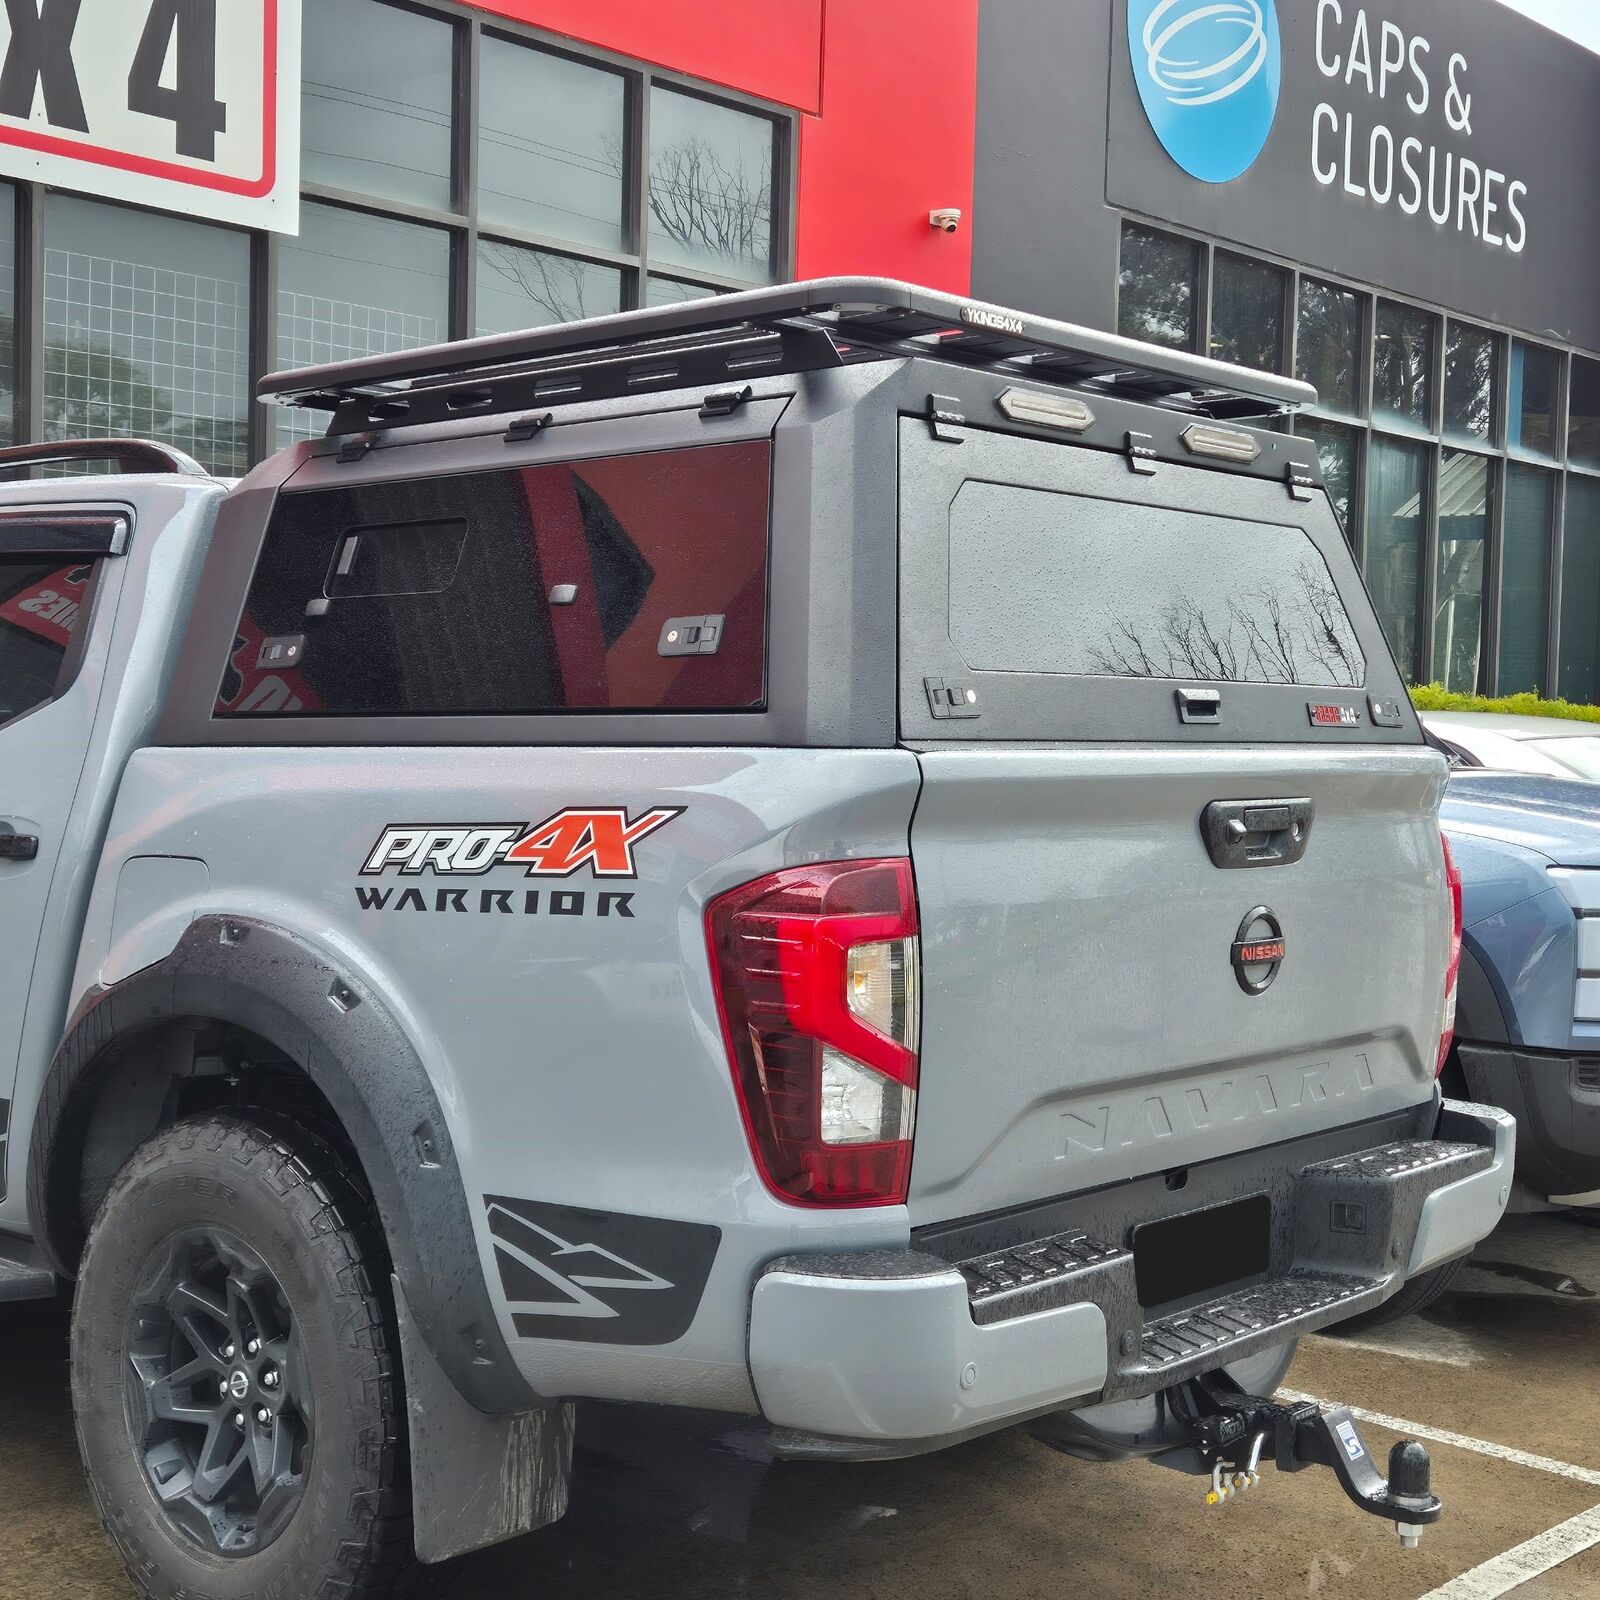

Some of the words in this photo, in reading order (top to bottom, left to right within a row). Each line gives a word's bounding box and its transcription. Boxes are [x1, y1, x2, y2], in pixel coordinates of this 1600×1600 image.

[1315, 0, 1430, 114] CAPS
[1444, 53, 1472, 135] &
[1311, 102, 1527, 252] CLOSURES
[357, 806, 689, 879] PRO-4X
[354, 887, 636, 918] WARRIOR
[1241, 944, 1284, 960] NISSAN
